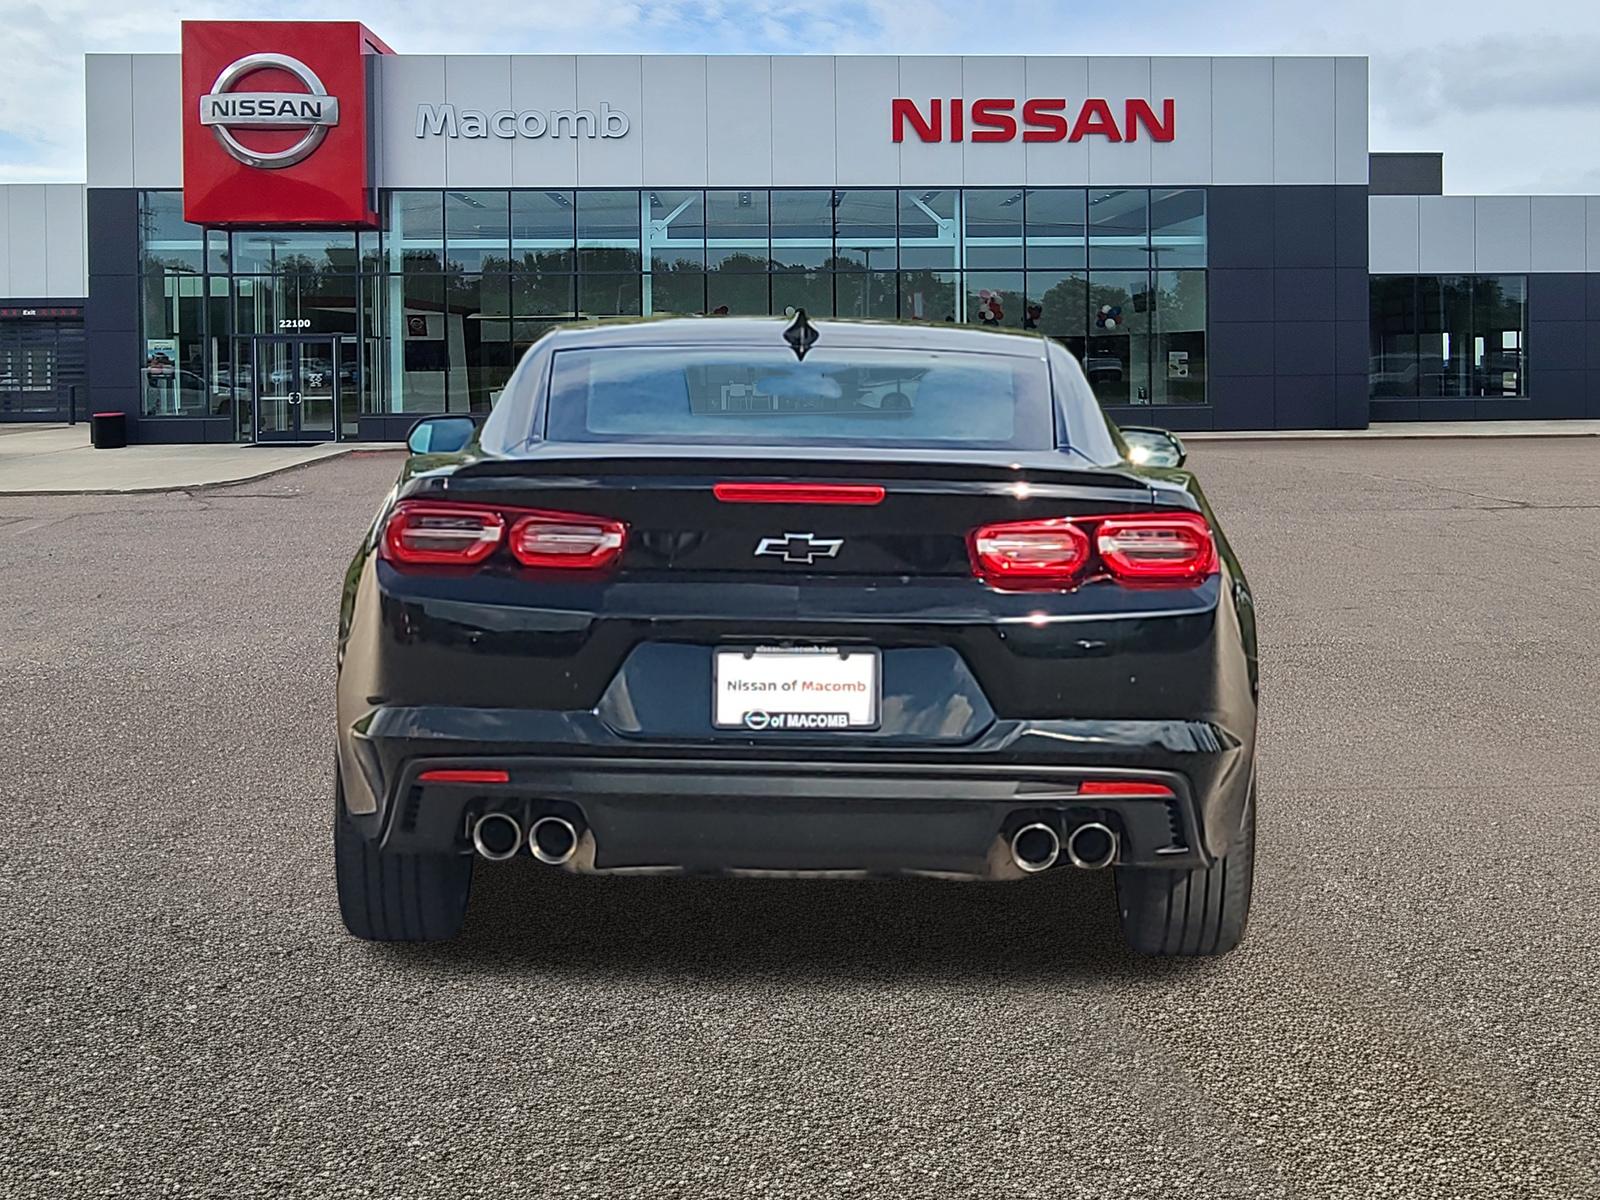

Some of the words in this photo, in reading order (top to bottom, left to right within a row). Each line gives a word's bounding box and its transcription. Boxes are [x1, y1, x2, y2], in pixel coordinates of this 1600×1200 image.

[211, 99, 323, 118] NISSAN
[415, 102, 630, 138] Macomb
[892, 98, 1175, 142] NISSAN
[279, 319, 311, 328] 22100
[727, 680, 777, 691] Nissan
[781, 680, 797, 691] of
[802, 681, 866, 692] Macomb
[770, 714, 784, 727] of
[787, 715, 848, 727] MACOMB
